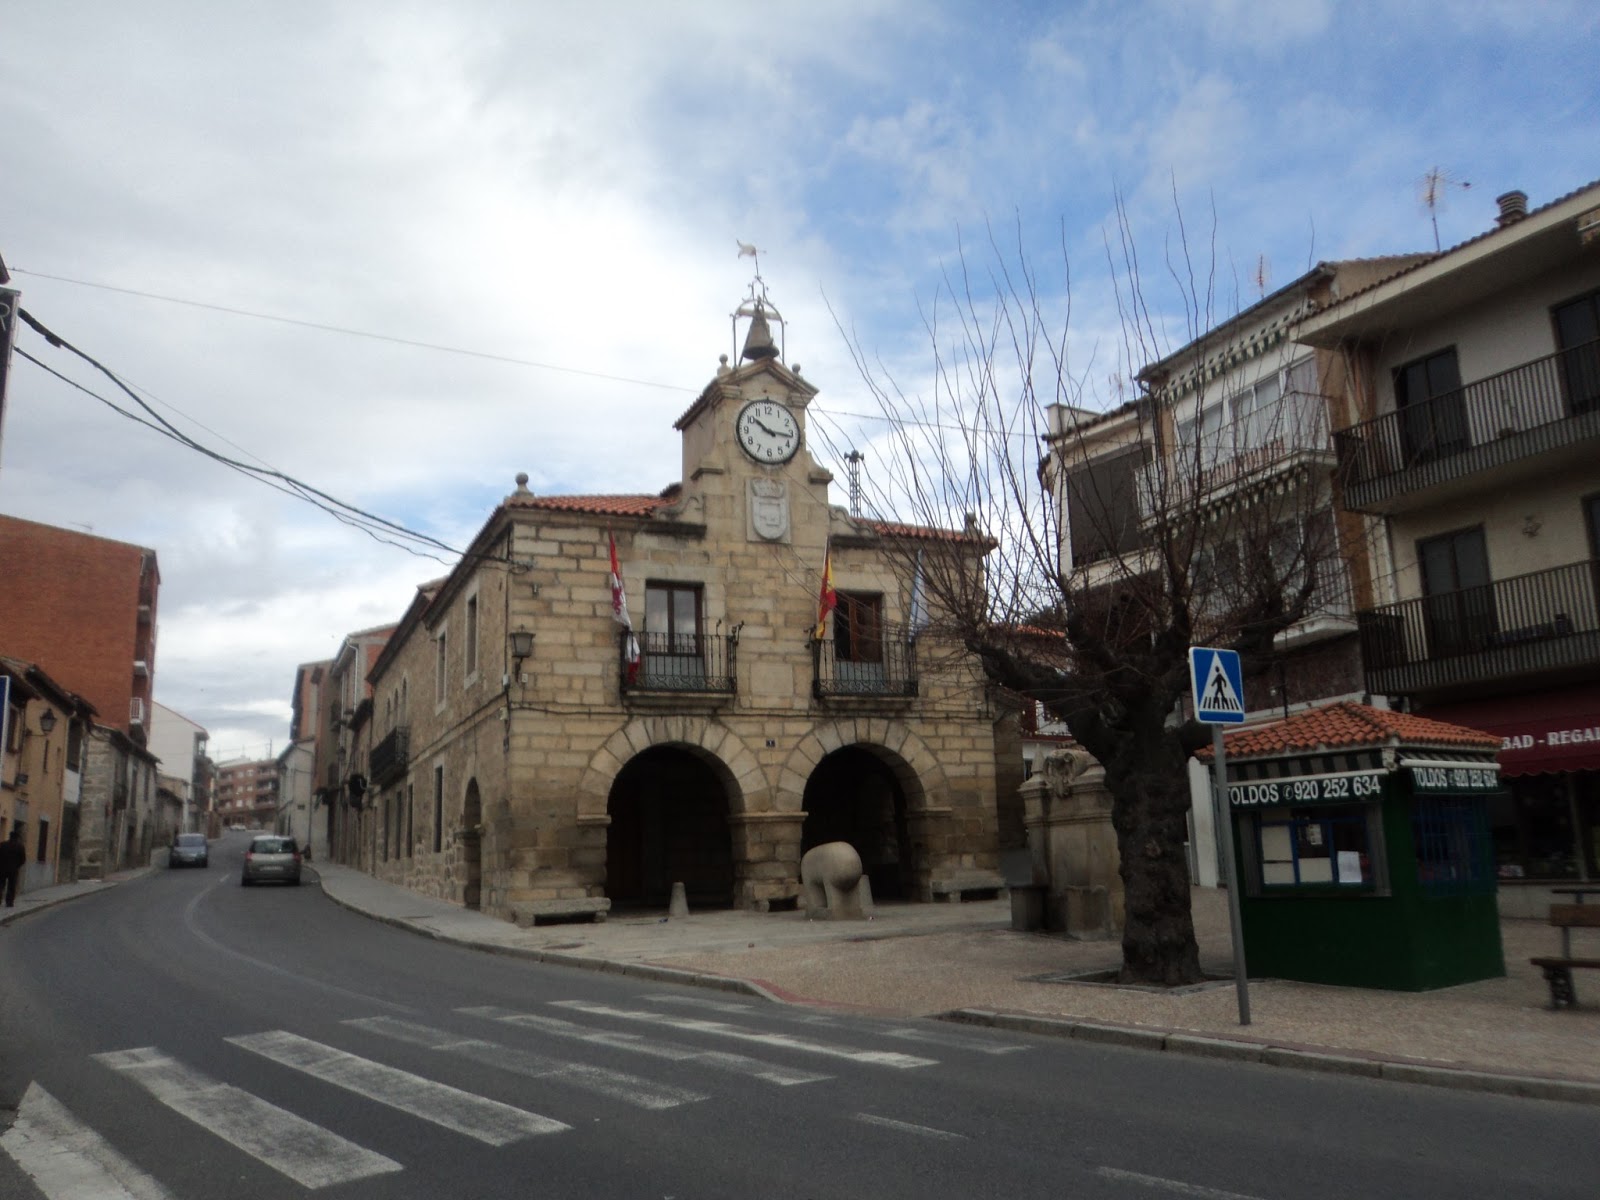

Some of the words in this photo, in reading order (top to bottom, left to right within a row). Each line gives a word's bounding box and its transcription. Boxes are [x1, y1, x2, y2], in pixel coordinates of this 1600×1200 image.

[755, 408, 760, 417] 11
[764, 406, 772, 415] 12
[747, 415, 755, 424] 10
[784, 418, 790, 427] 2
[744, 426, 749, 434] 9
[789, 430, 794, 438] 3
[748, 436, 753, 445] 8
[785, 439, 790, 448] 4
[757, 443, 761, 453] 7
[767, 448, 772, 457] 6
[778, 446, 783, 455] 5
[1412, 767, 1448, 787] TOLDOS
[1454, 768, 1470, 787] 920
[1469, 769, 1484, 787] 252
[1483, 769, 1498, 787] 634
[1227, 783, 1279, 805] OLDOS
[1294, 780, 1319, 800] 920
[1323, 778, 1350, 798] 252
[1353, 775, 1381, 796] 634
